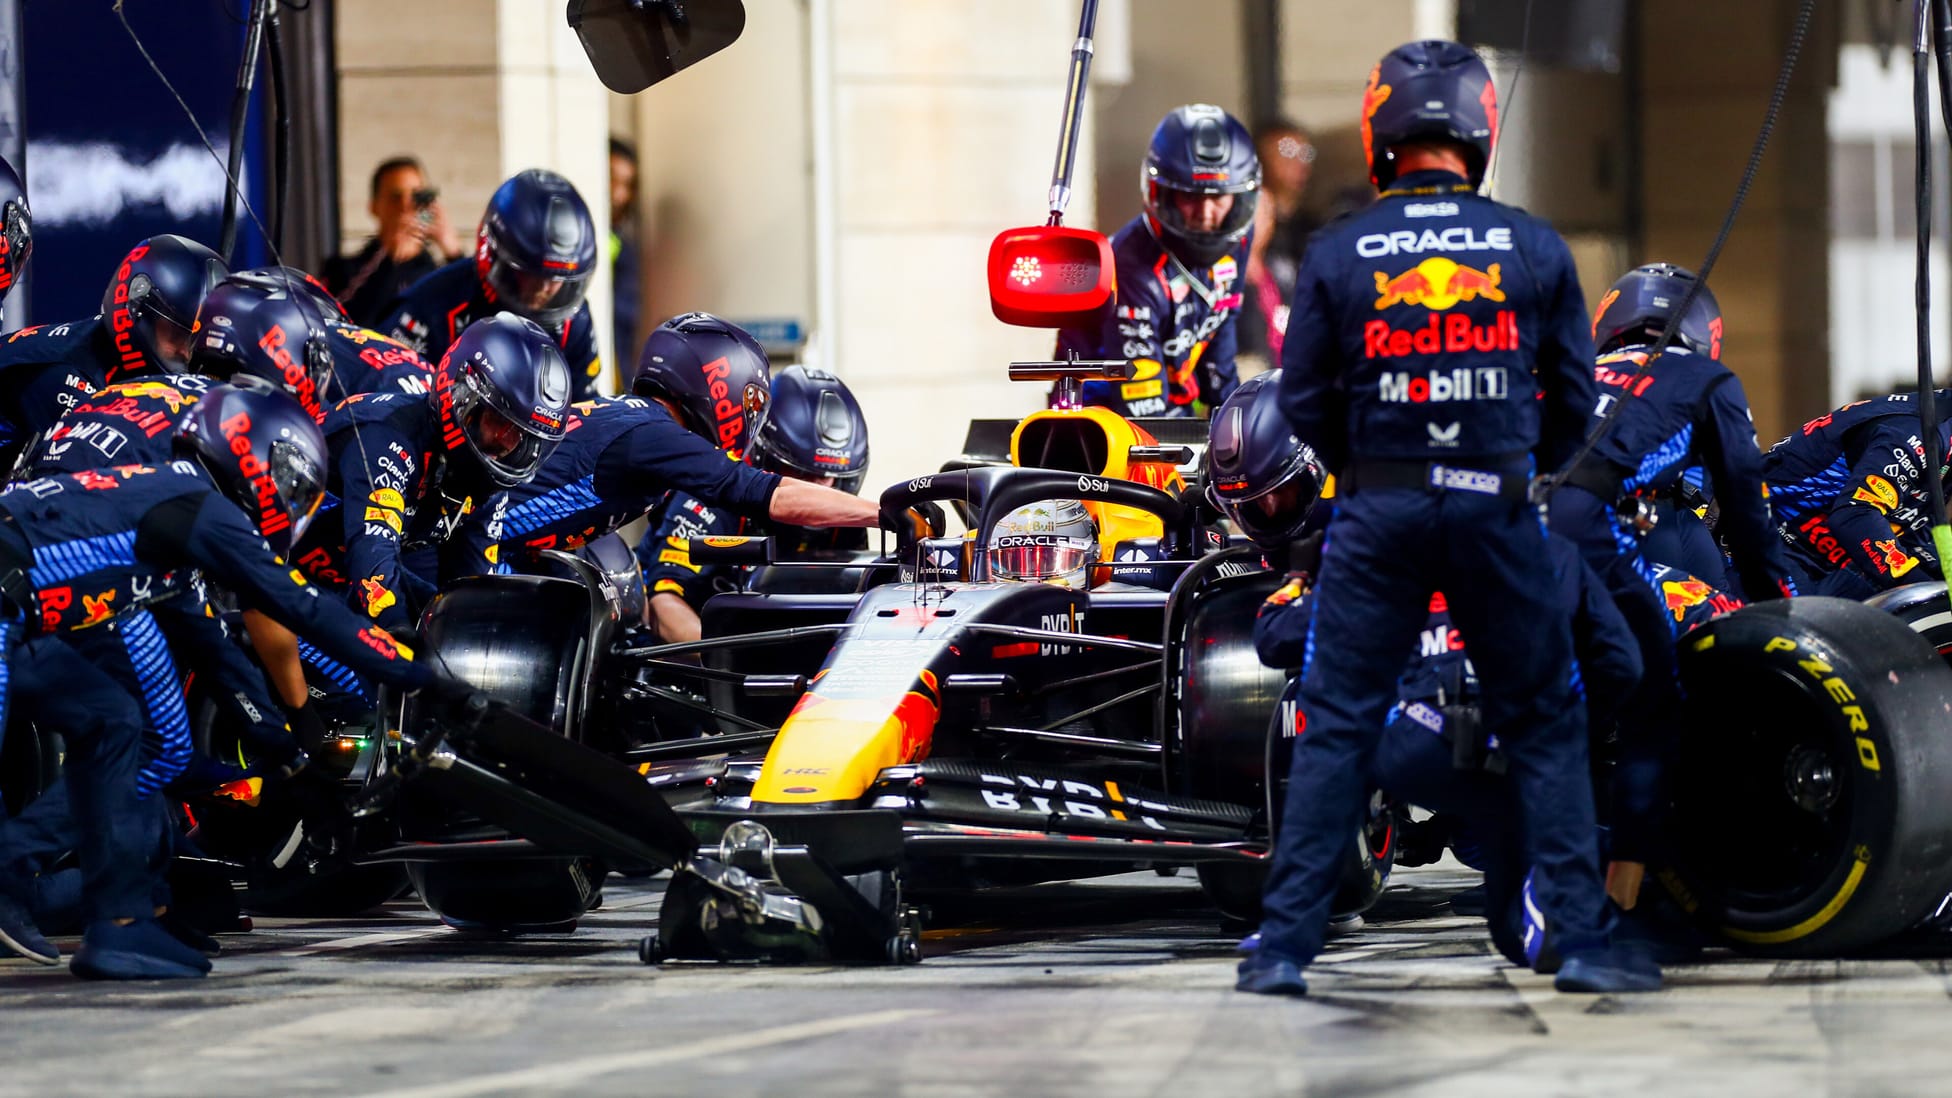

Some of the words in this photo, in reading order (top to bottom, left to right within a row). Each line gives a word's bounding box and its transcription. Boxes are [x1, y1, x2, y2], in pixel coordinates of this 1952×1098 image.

[1356, 227, 1513, 258] ORACLE
[1364, 312, 1441, 359] Red
[1445, 310, 1519, 352] Bull
[702, 356, 743, 421] Red
[1379, 368, 1472, 404] Mobil
[219, 411, 269, 479] Red
[1000, 535, 1069, 547] ORACLE
[1113, 567, 1152, 575] inter.mx
[1764, 636, 1798, 653] P
[1798, 653, 1880, 771] ZERO
